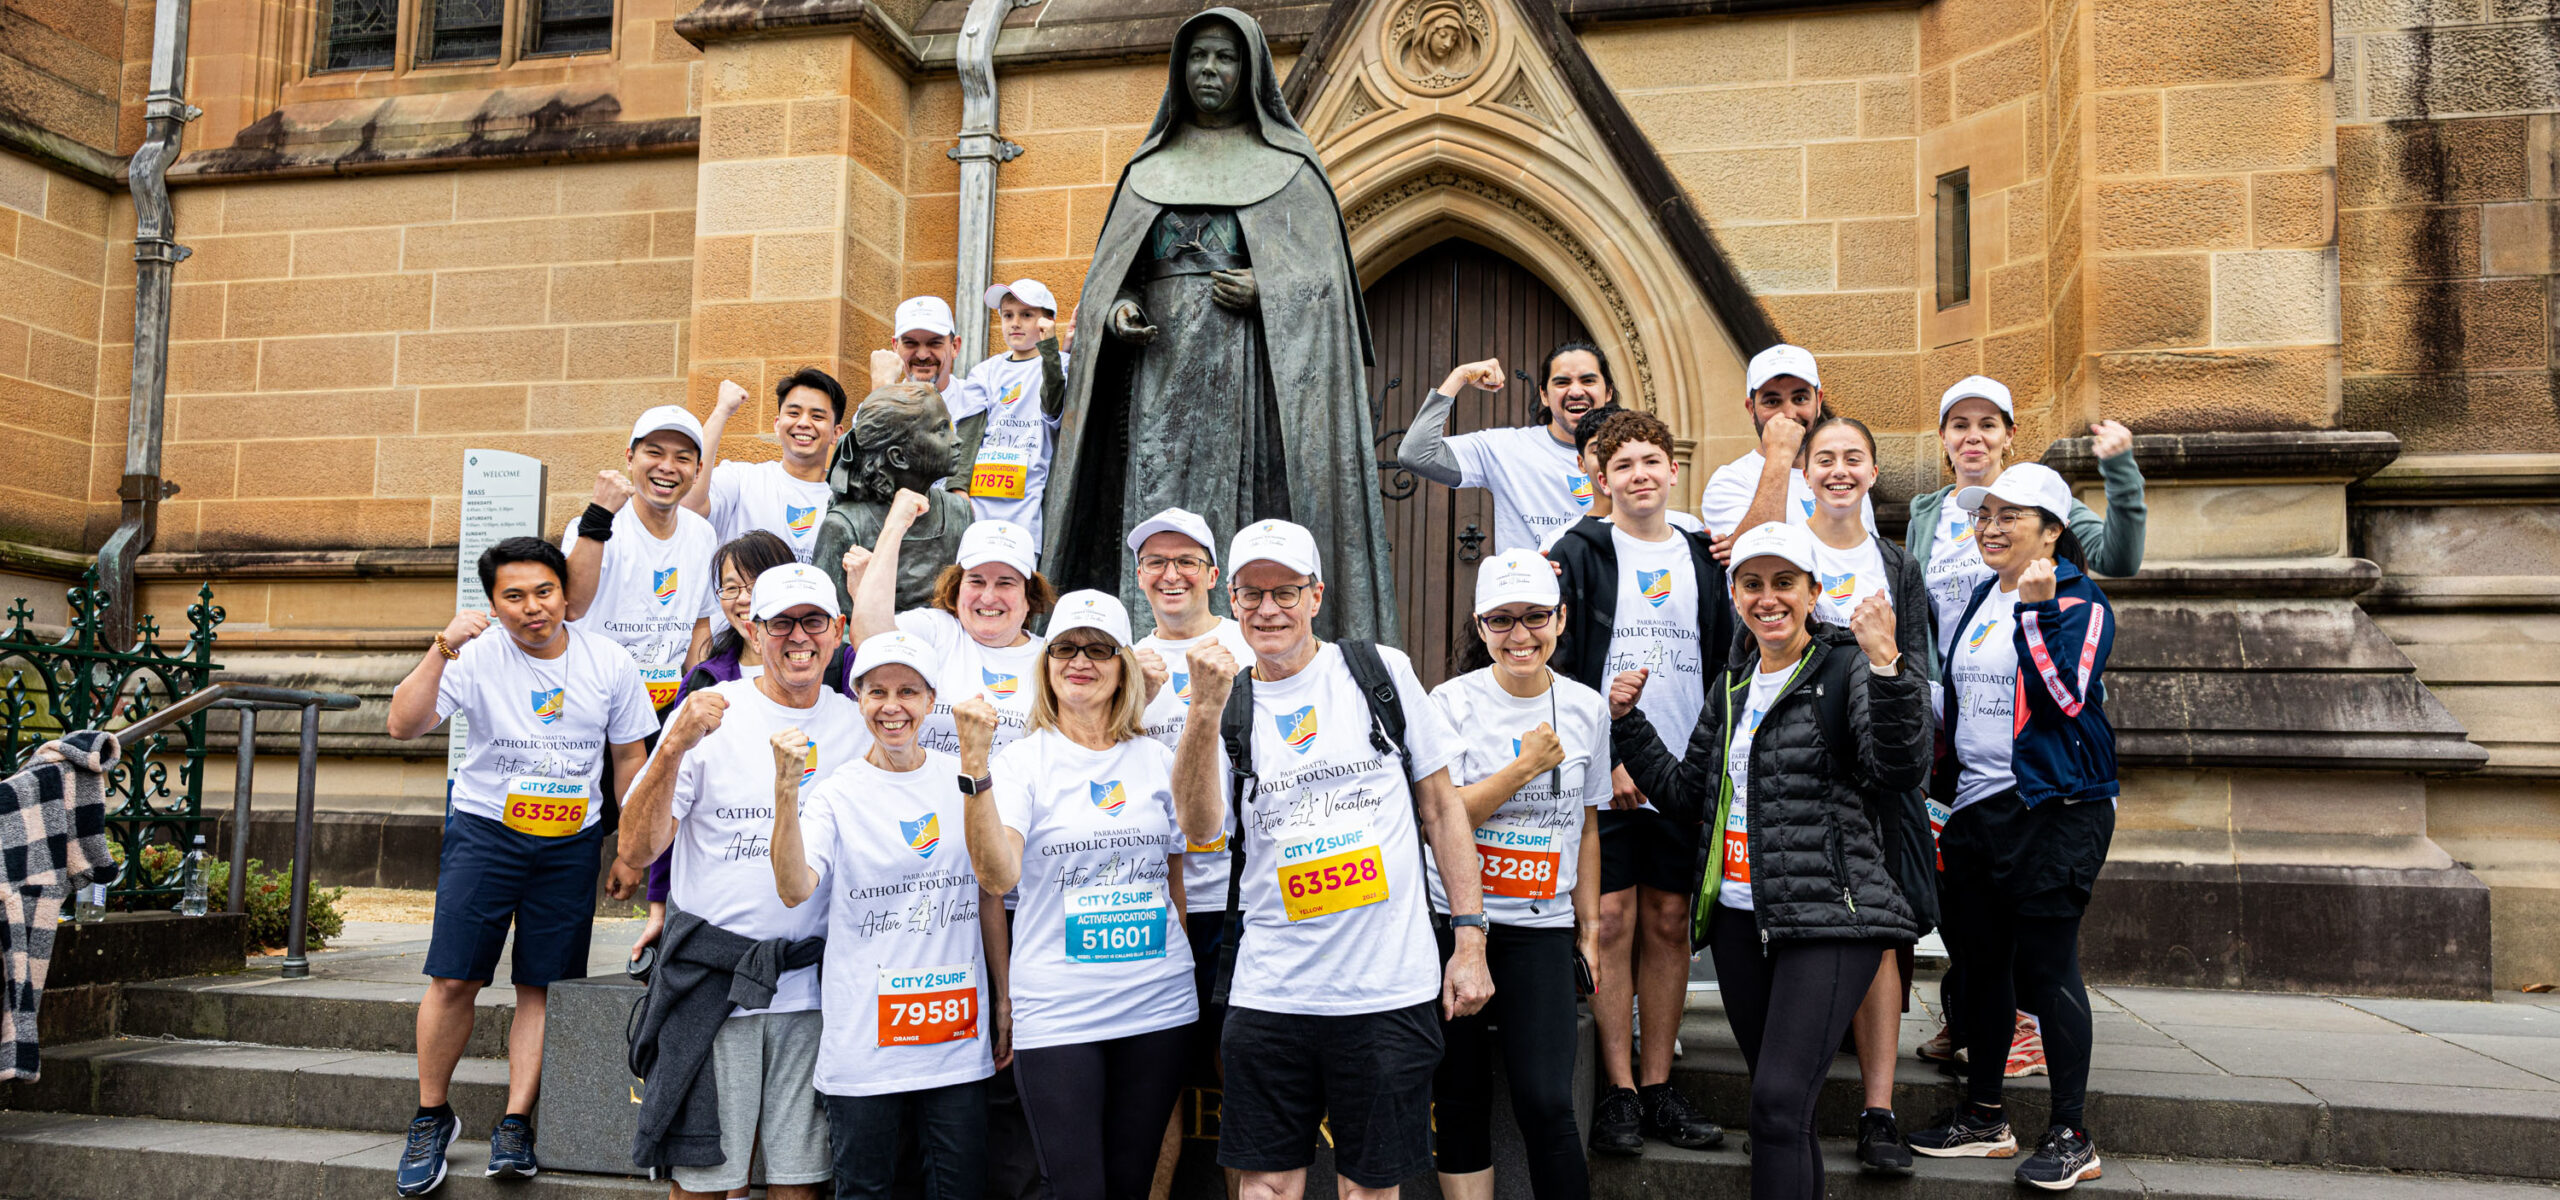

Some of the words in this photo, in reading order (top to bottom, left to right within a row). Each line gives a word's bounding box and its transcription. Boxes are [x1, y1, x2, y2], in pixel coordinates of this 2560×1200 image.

[483, 470, 520, 478] WELCOME
[974, 474, 1014, 489] 17875
[604, 620, 655, 633] CATHOLIC
[1612, 627, 1649, 639] HOLIC
[1651, 627, 1699, 640] FOUNDA
[639, 669, 677, 679] TY2SURF
[1964, 672, 2015, 686] FOUNDATIO
[648, 688, 677, 704] 527
[1146, 723, 1179, 737] HOLIC
[493, 755, 527, 775] Active
[1280, 759, 1328, 778] PARRAMATTA
[1256, 778, 1295, 797] HOLIC
[1296, 759, 1383, 785] FOUNDATION
[520, 781, 583, 794] CITY2SURF
[511, 802, 582, 821] 63526
[716, 807, 774, 819] CATHOL
[1250, 809, 1285, 836] Ative
[1324, 787, 1383, 818] Vocations
[1093, 827, 1141, 837] PARRAMATTA
[1474, 827, 1551, 846] CITY2SURF
[724, 831, 770, 861] Active
[1042, 838, 1107, 857] CATHOLIC
[1284, 830, 1364, 859] CITY2SURF
[903, 869, 950, 881] PARRAMATTA
[1052, 866, 1090, 893] Active
[1128, 857, 1167, 885] Vocatio
[1288, 858, 1378, 898] 63528
[850, 881, 917, 900] CATHOLIC
[1077, 891, 1153, 907] CITY2SURF
[858, 910, 902, 938] Active
[940, 899, 978, 929] Vocation
[1077, 910, 1157, 925] ACTIVE4VOCATIONS
[1299, 905, 1324, 915] YELLOW
[1082, 925, 1150, 950] 51601
[891, 971, 967, 989] CITY2SURF
[890, 997, 970, 1026] 79581
